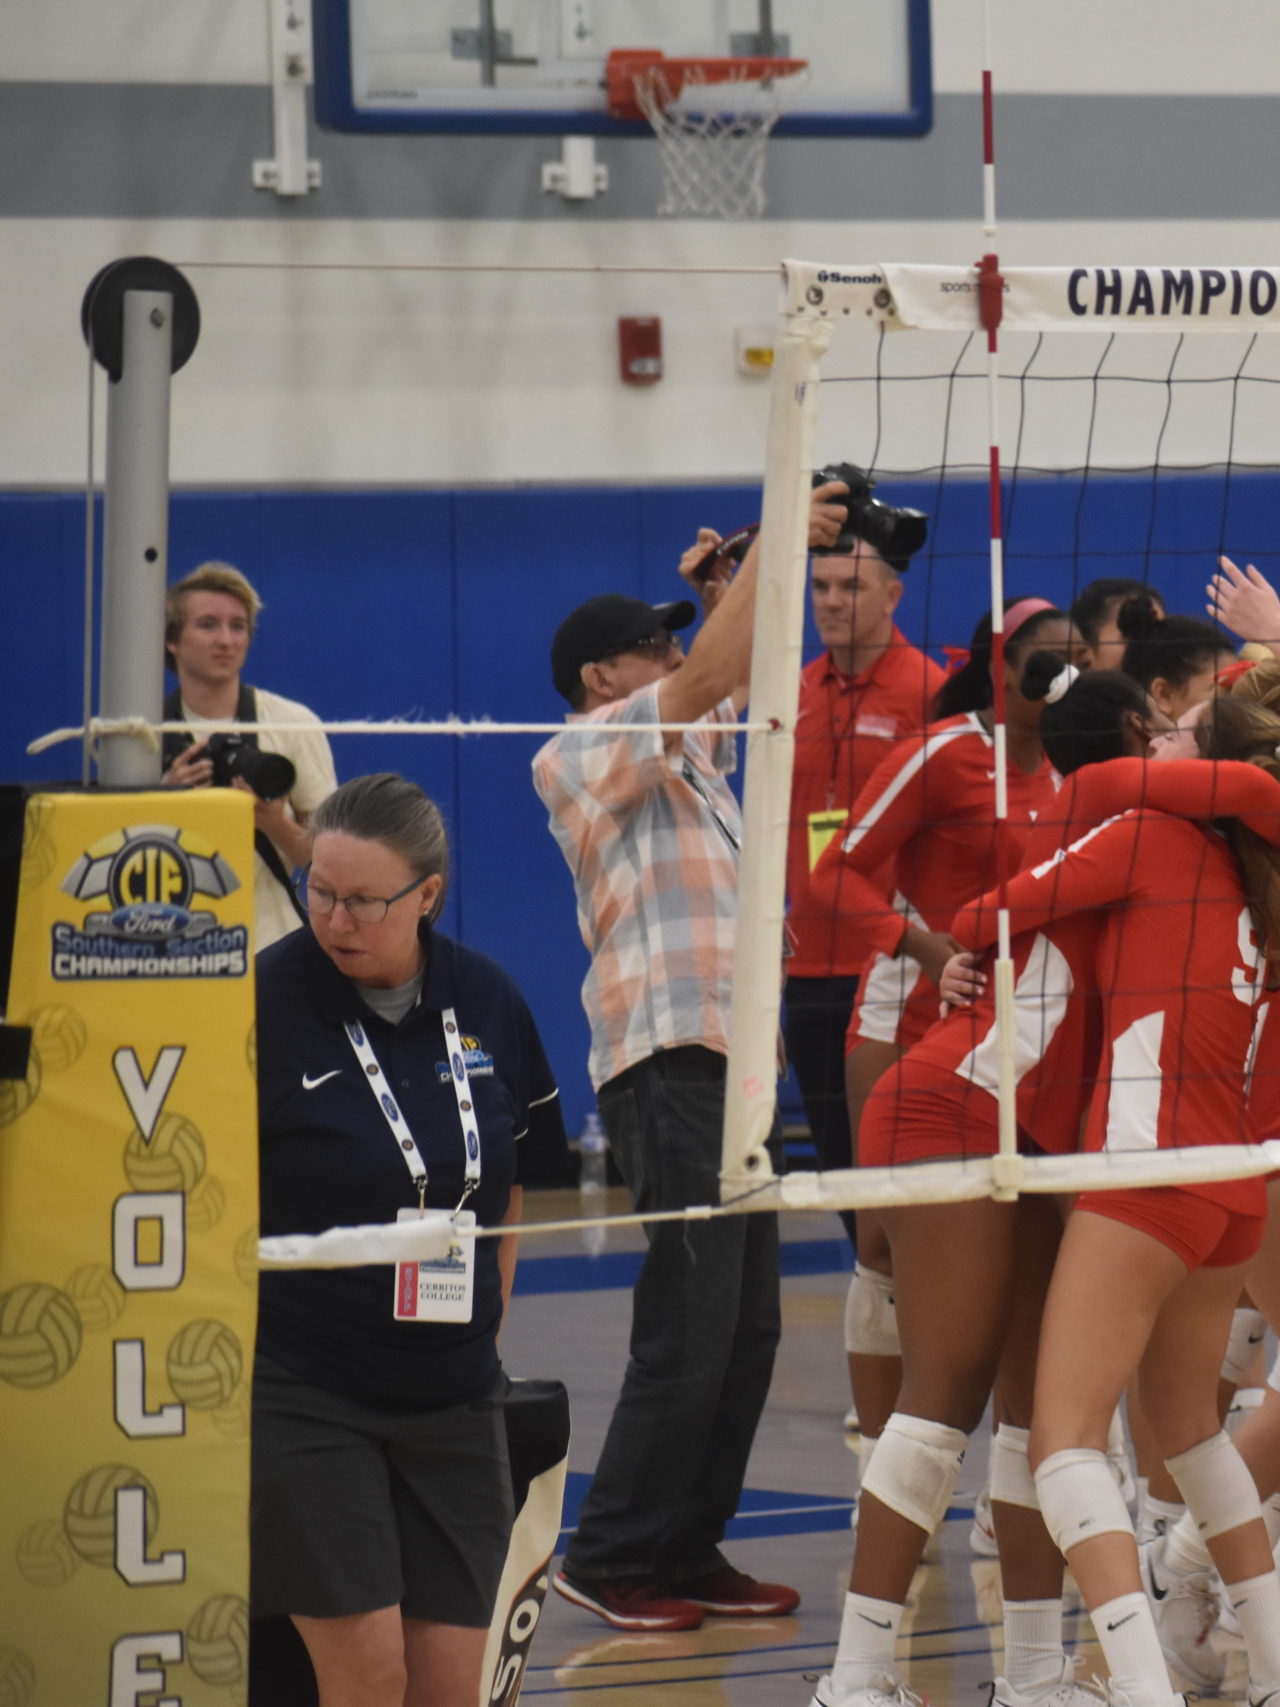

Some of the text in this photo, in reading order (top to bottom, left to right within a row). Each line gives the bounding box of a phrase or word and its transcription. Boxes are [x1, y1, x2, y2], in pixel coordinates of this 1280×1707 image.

[830, 272, 882, 284] Senoh
[119, 847, 183, 907] CIF
[123, 910, 176, 934] Ford
[54, 924, 246, 958] Southern Section
[54, 950, 246, 977] CHAMPIONSHIPS
[419, 1283, 466, 1293] CERRITOS
[420, 1291, 465, 1302] COLLEGE
